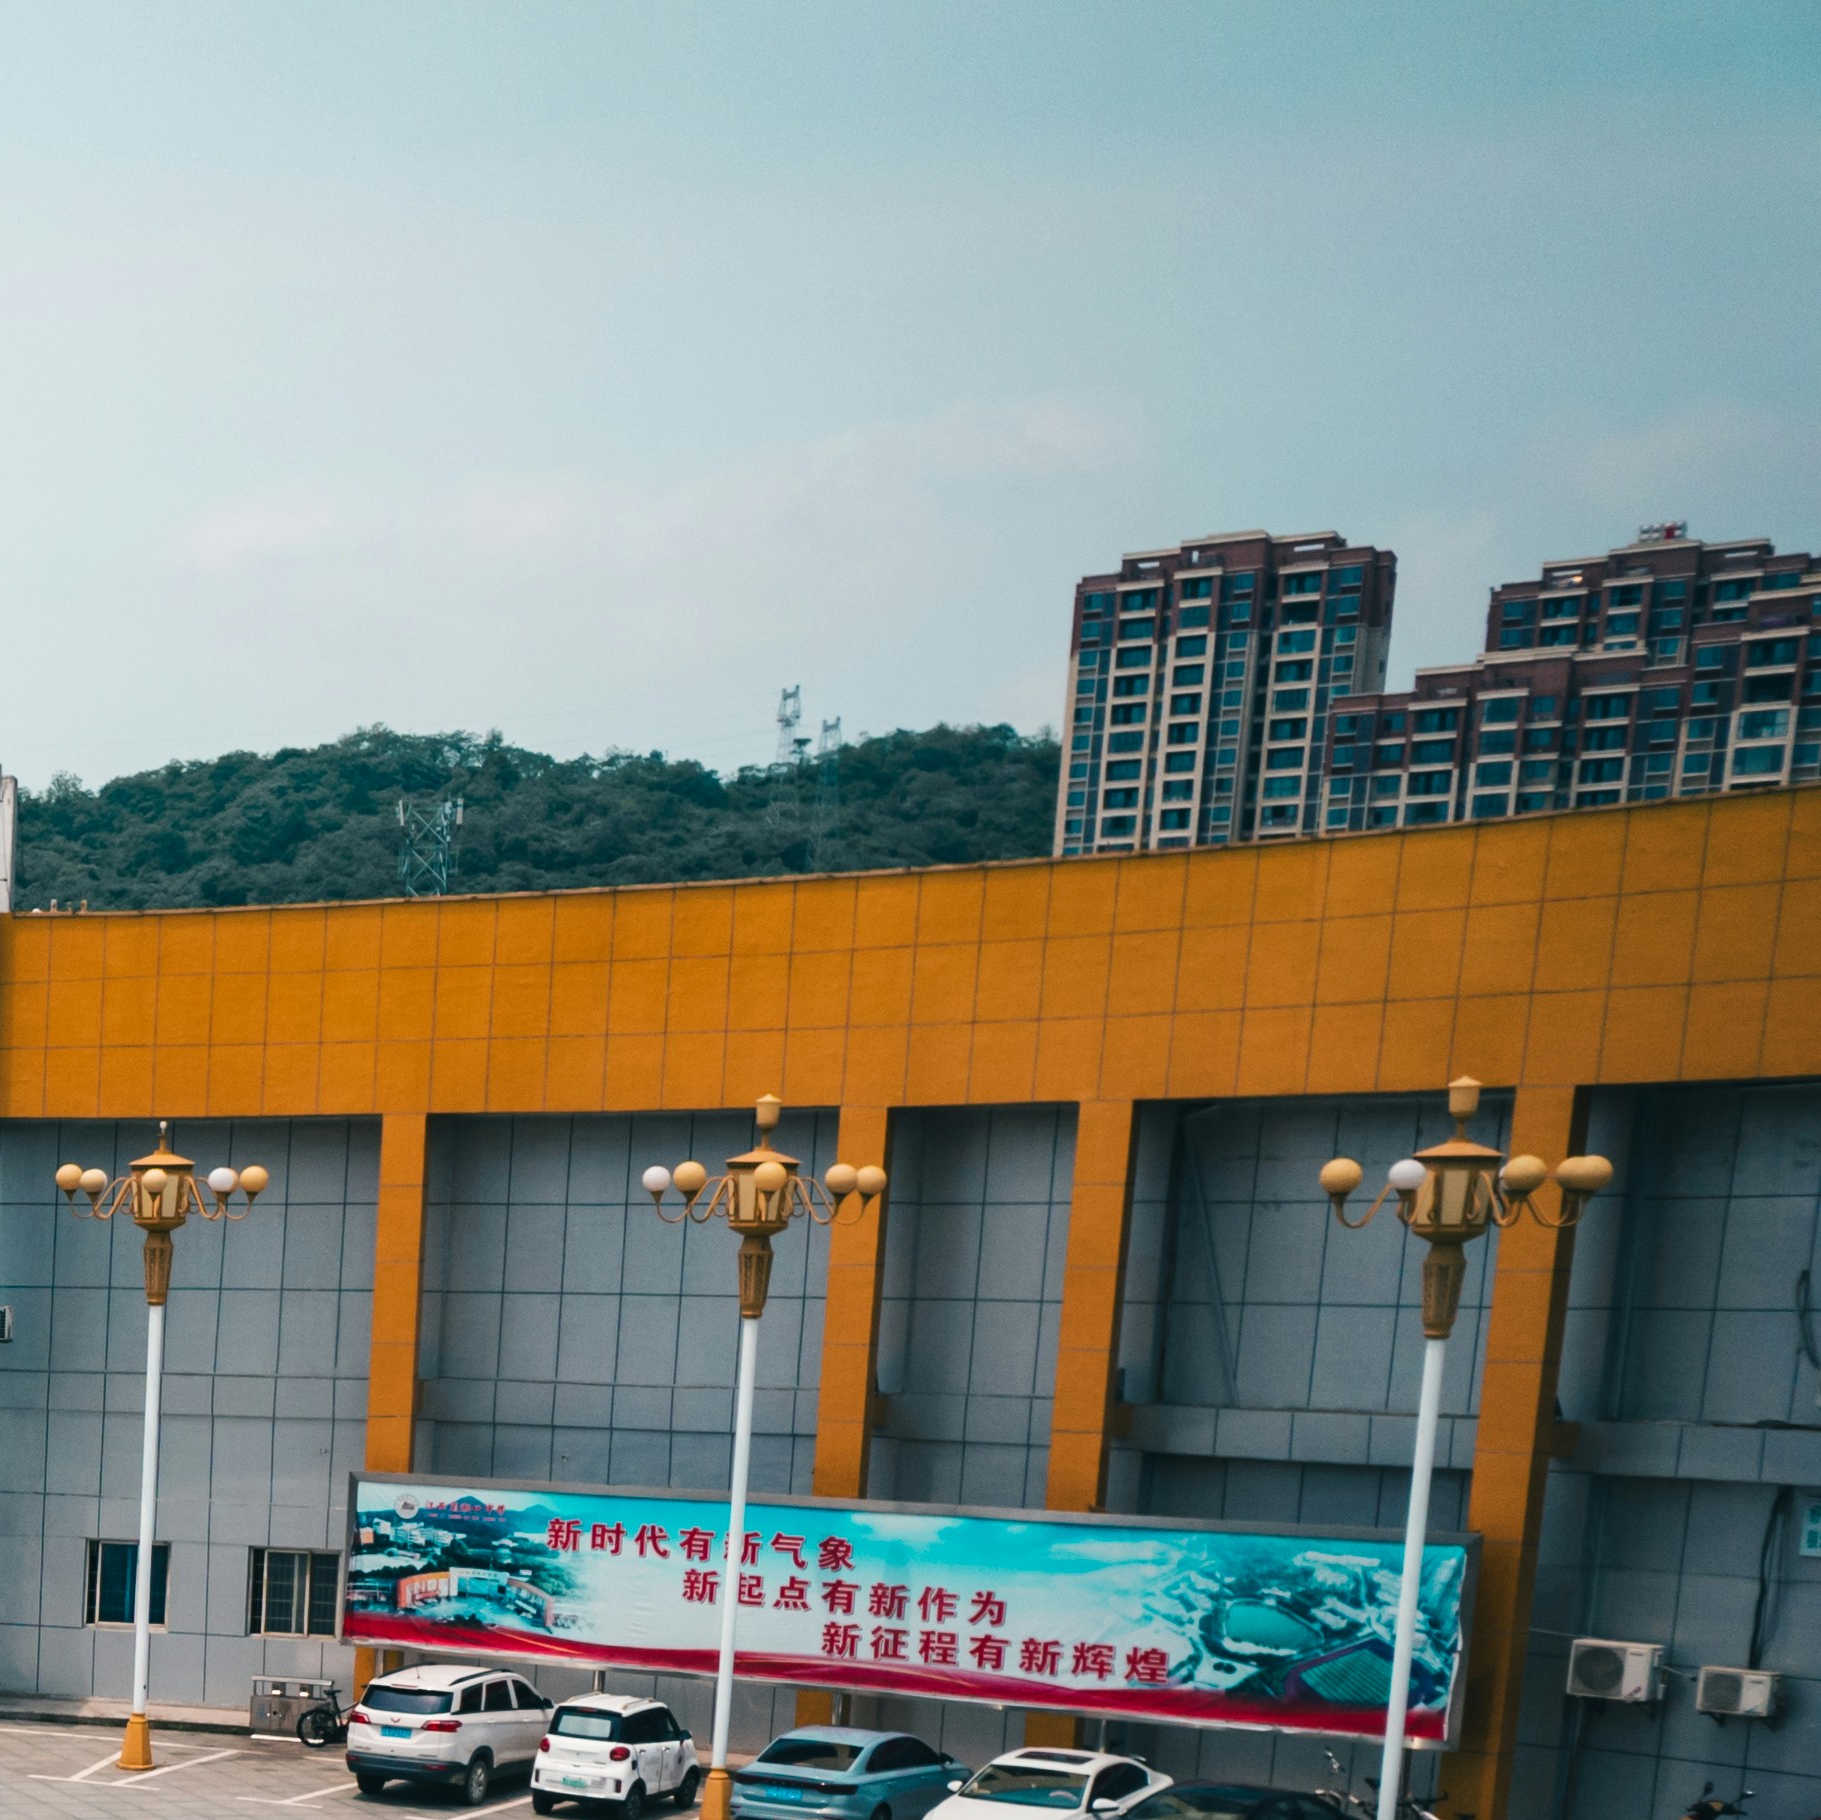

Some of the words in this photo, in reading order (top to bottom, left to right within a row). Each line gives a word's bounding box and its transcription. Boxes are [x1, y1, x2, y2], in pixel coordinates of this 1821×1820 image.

[548, 1519, 855, 1572] 新时代有新气象
[821, 1621, 1170, 1685] 新征程有新辉煌
